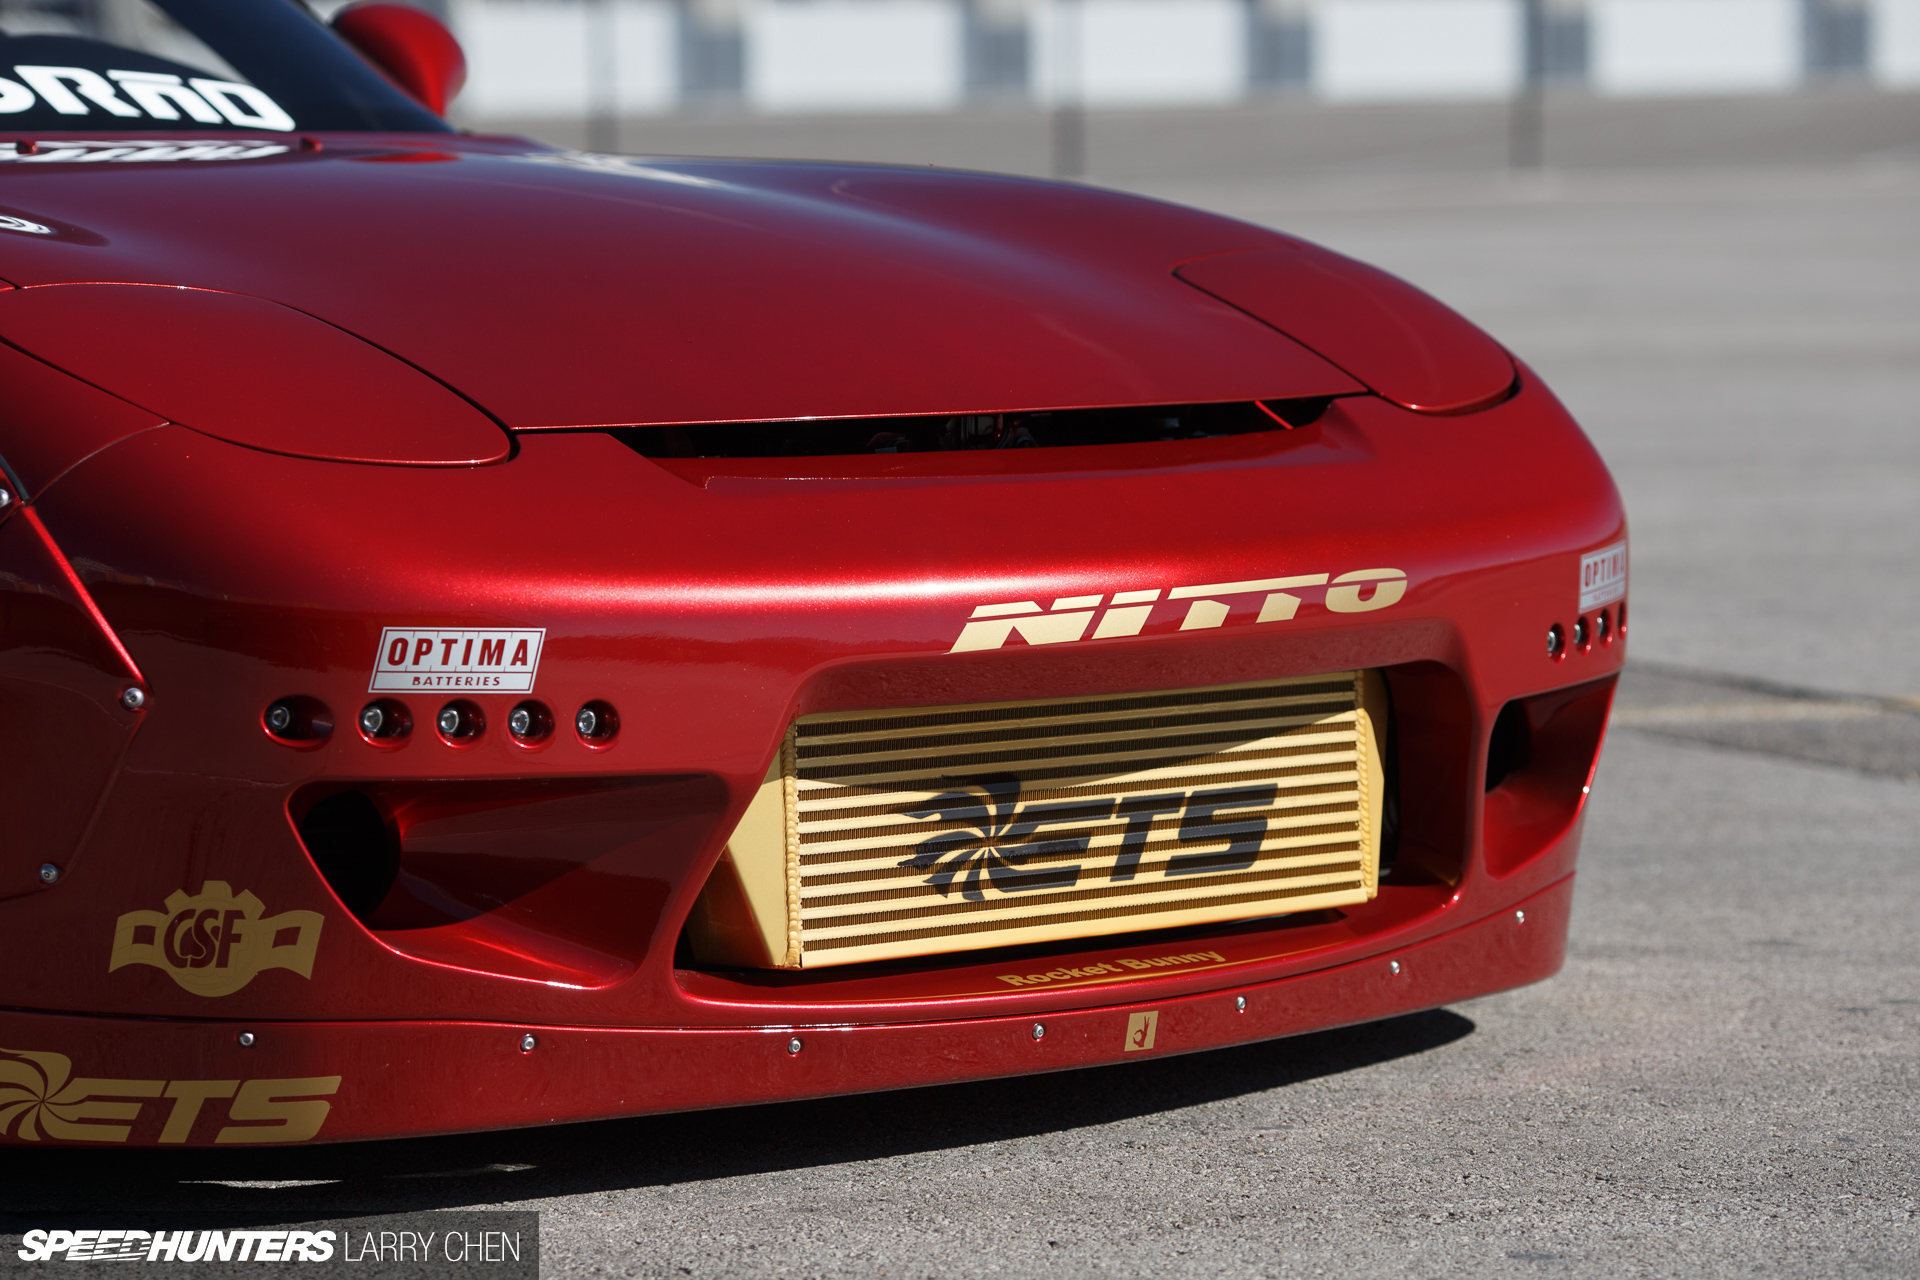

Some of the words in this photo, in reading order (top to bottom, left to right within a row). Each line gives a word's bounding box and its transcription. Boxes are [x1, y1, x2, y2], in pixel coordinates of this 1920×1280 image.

[947, 567, 1407, 655] NITTO
[387, 637, 528, 666] OPTIMA
[412, 676, 501, 686] BATTERIES
[987, 782, 1278, 895] ETS
[163, 908, 248, 969] CSF
[996, 962, 1123, 986] Rocket
[1115, 951, 1226, 970] Bunny
[42, 1075, 342, 1143] ETS
